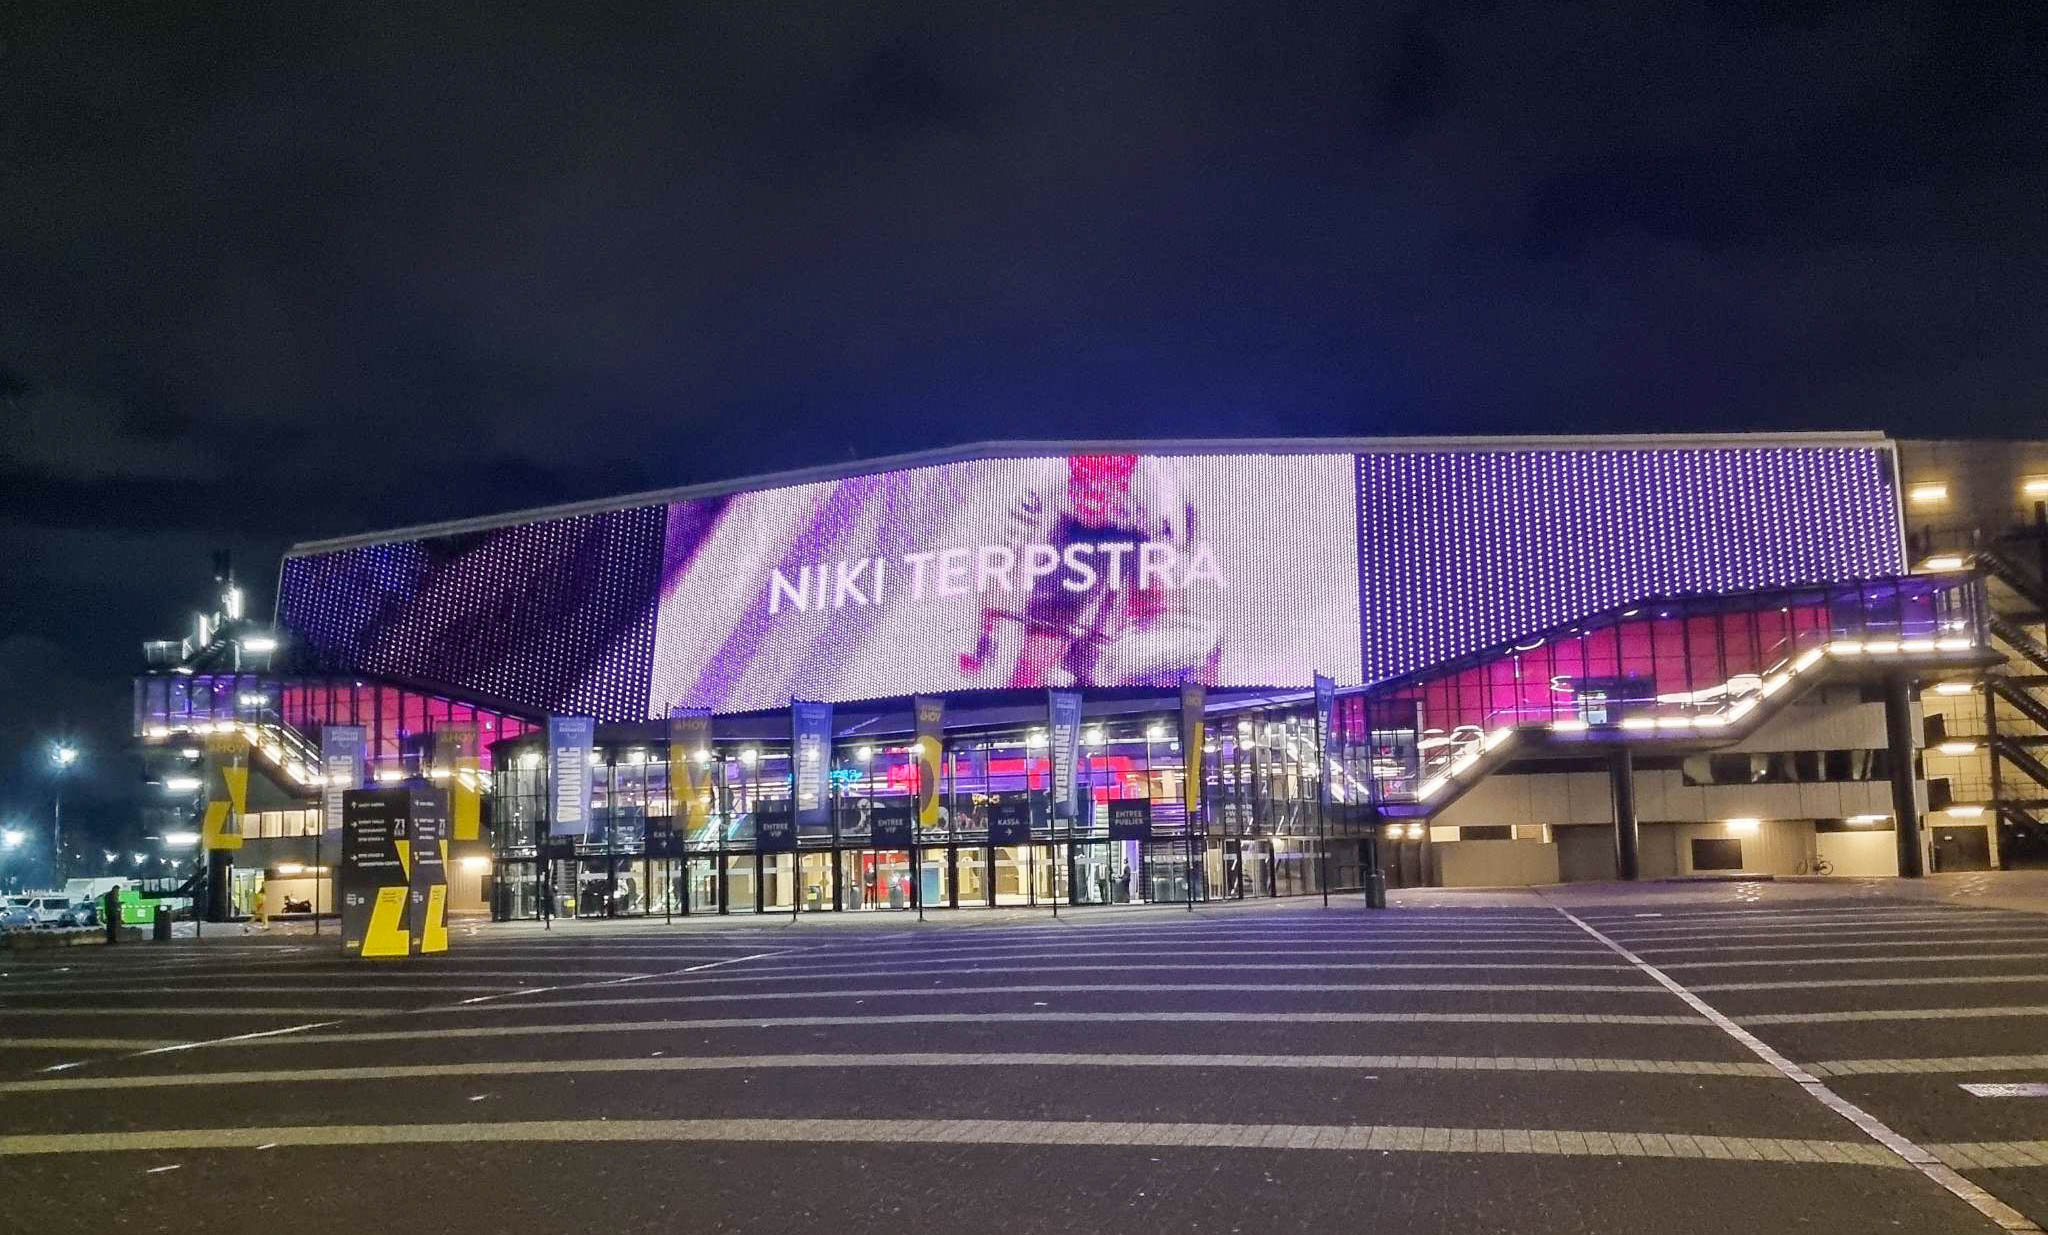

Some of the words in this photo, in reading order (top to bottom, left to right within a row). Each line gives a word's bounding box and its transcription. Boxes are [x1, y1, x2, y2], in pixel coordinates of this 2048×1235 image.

[768, 557, 886, 615] NIKI
[904, 541, 1229, 598] TERPSTRA
[557, 747, 582, 822] WOONING
